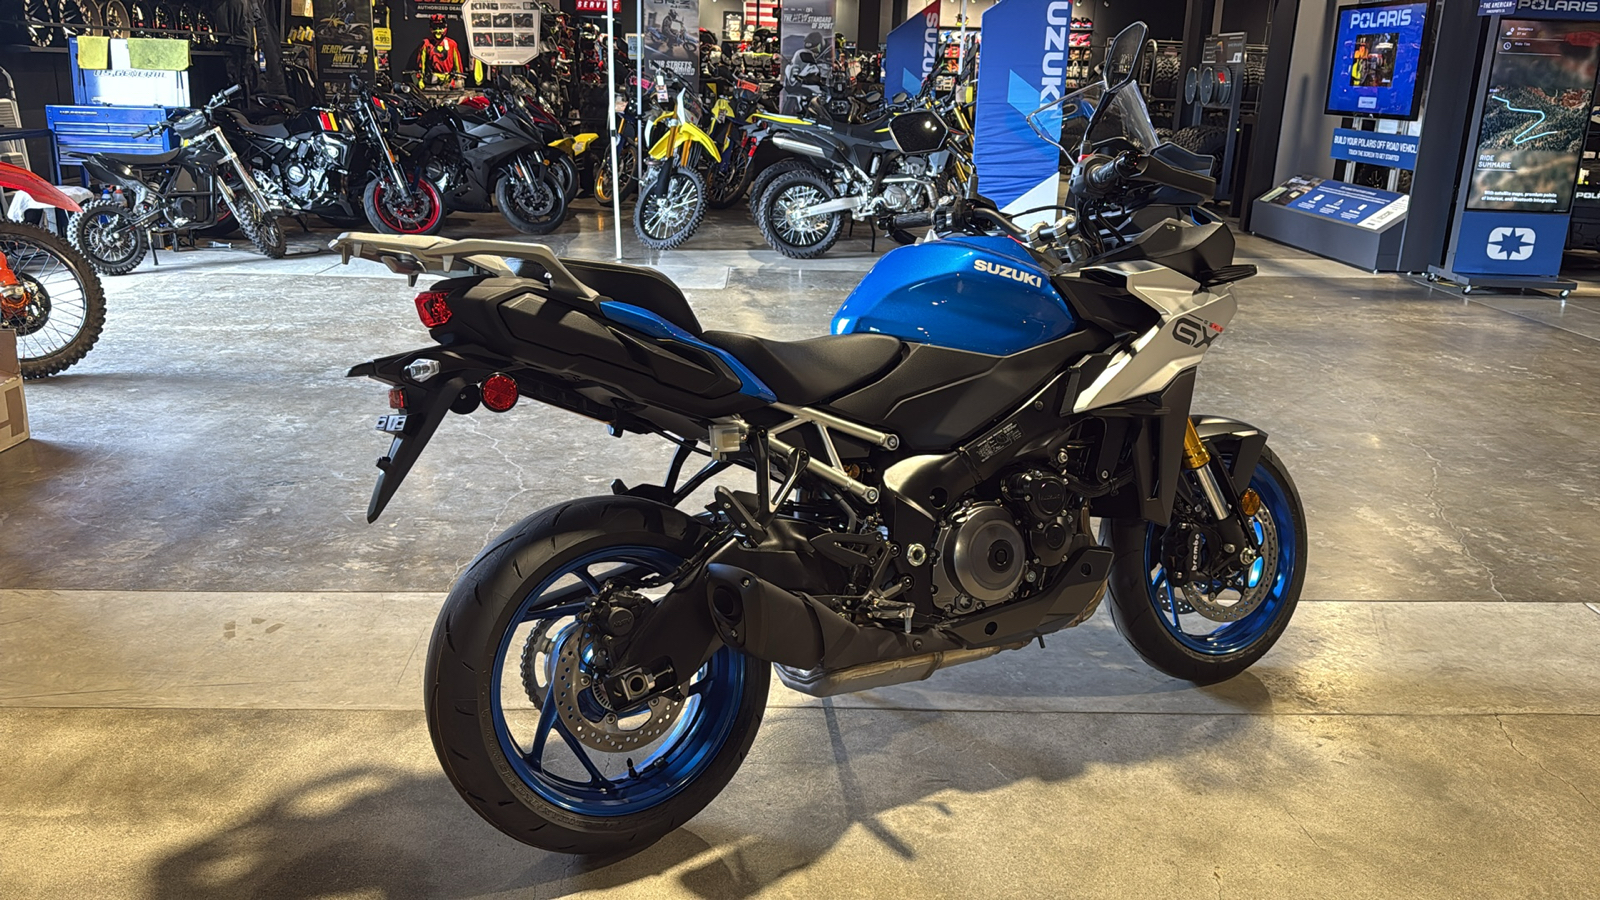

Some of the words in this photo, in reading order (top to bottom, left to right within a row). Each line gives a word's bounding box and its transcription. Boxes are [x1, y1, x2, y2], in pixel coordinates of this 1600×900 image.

[471, 2, 498, 10] KING
[577, 1, 618, 9] SERVIE
[1517, 0, 1598, 12] POLARIS
[1350, 9, 1412, 29] POLARIS
[320, 44, 343, 53] READY
[921, 12, 938, 85] SUZU
[1040, 1, 1068, 110] UZUKI
[665, 60, 693, 69] STREETS
[1333, 135, 1346, 145] BUILD
[1346, 136, 1358, 146] YOUR
[1358, 138, 1376, 149] POLARIS
[1376, 140, 1386, 149] OFF
[1386, 141, 1399, 151] ROAD
[1399, 143, 1418, 154] VEHICL
[973, 259, 1042, 288] SUZUKI
[1191, 533, 1200, 571] brembo
